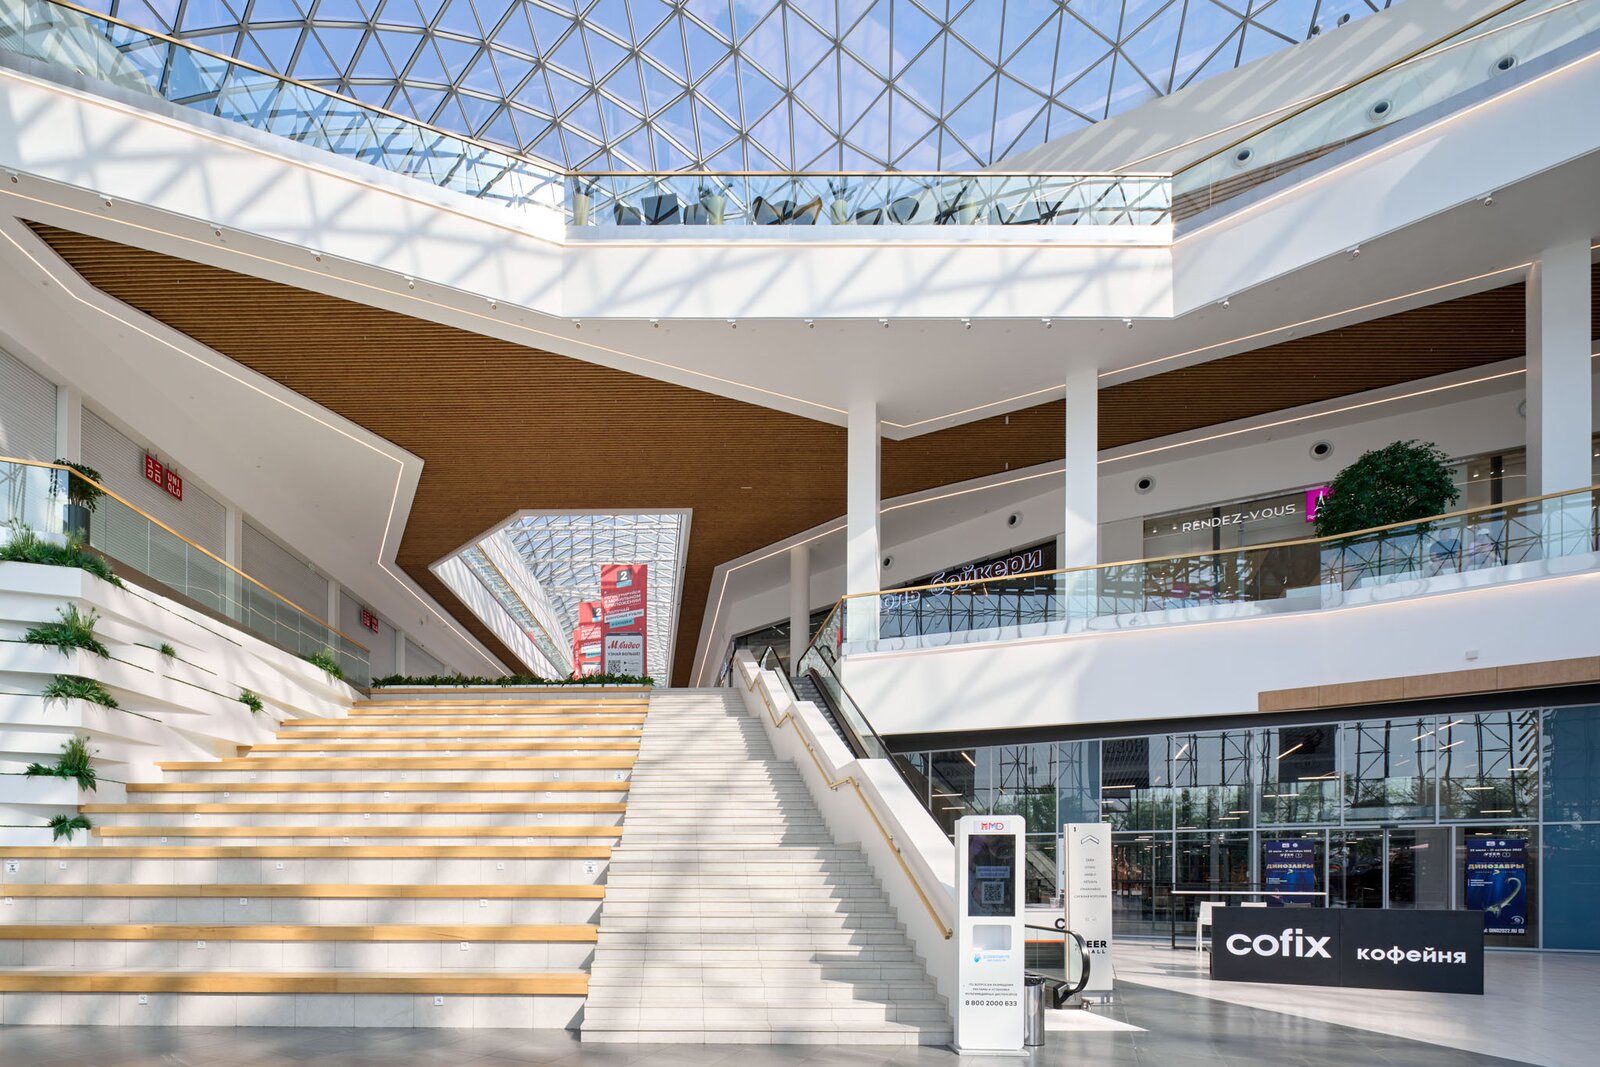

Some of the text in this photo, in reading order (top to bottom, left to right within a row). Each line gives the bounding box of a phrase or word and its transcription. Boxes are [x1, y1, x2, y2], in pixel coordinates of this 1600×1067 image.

[1182, 503, 1296, 532] RENDEZ-VOUS
[620, 571, 628, 581] 2
[1086, 940, 1107, 948] EER
[1226, 928, 1331, 959] cofix
[1357, 945, 1467, 964] кофейня
